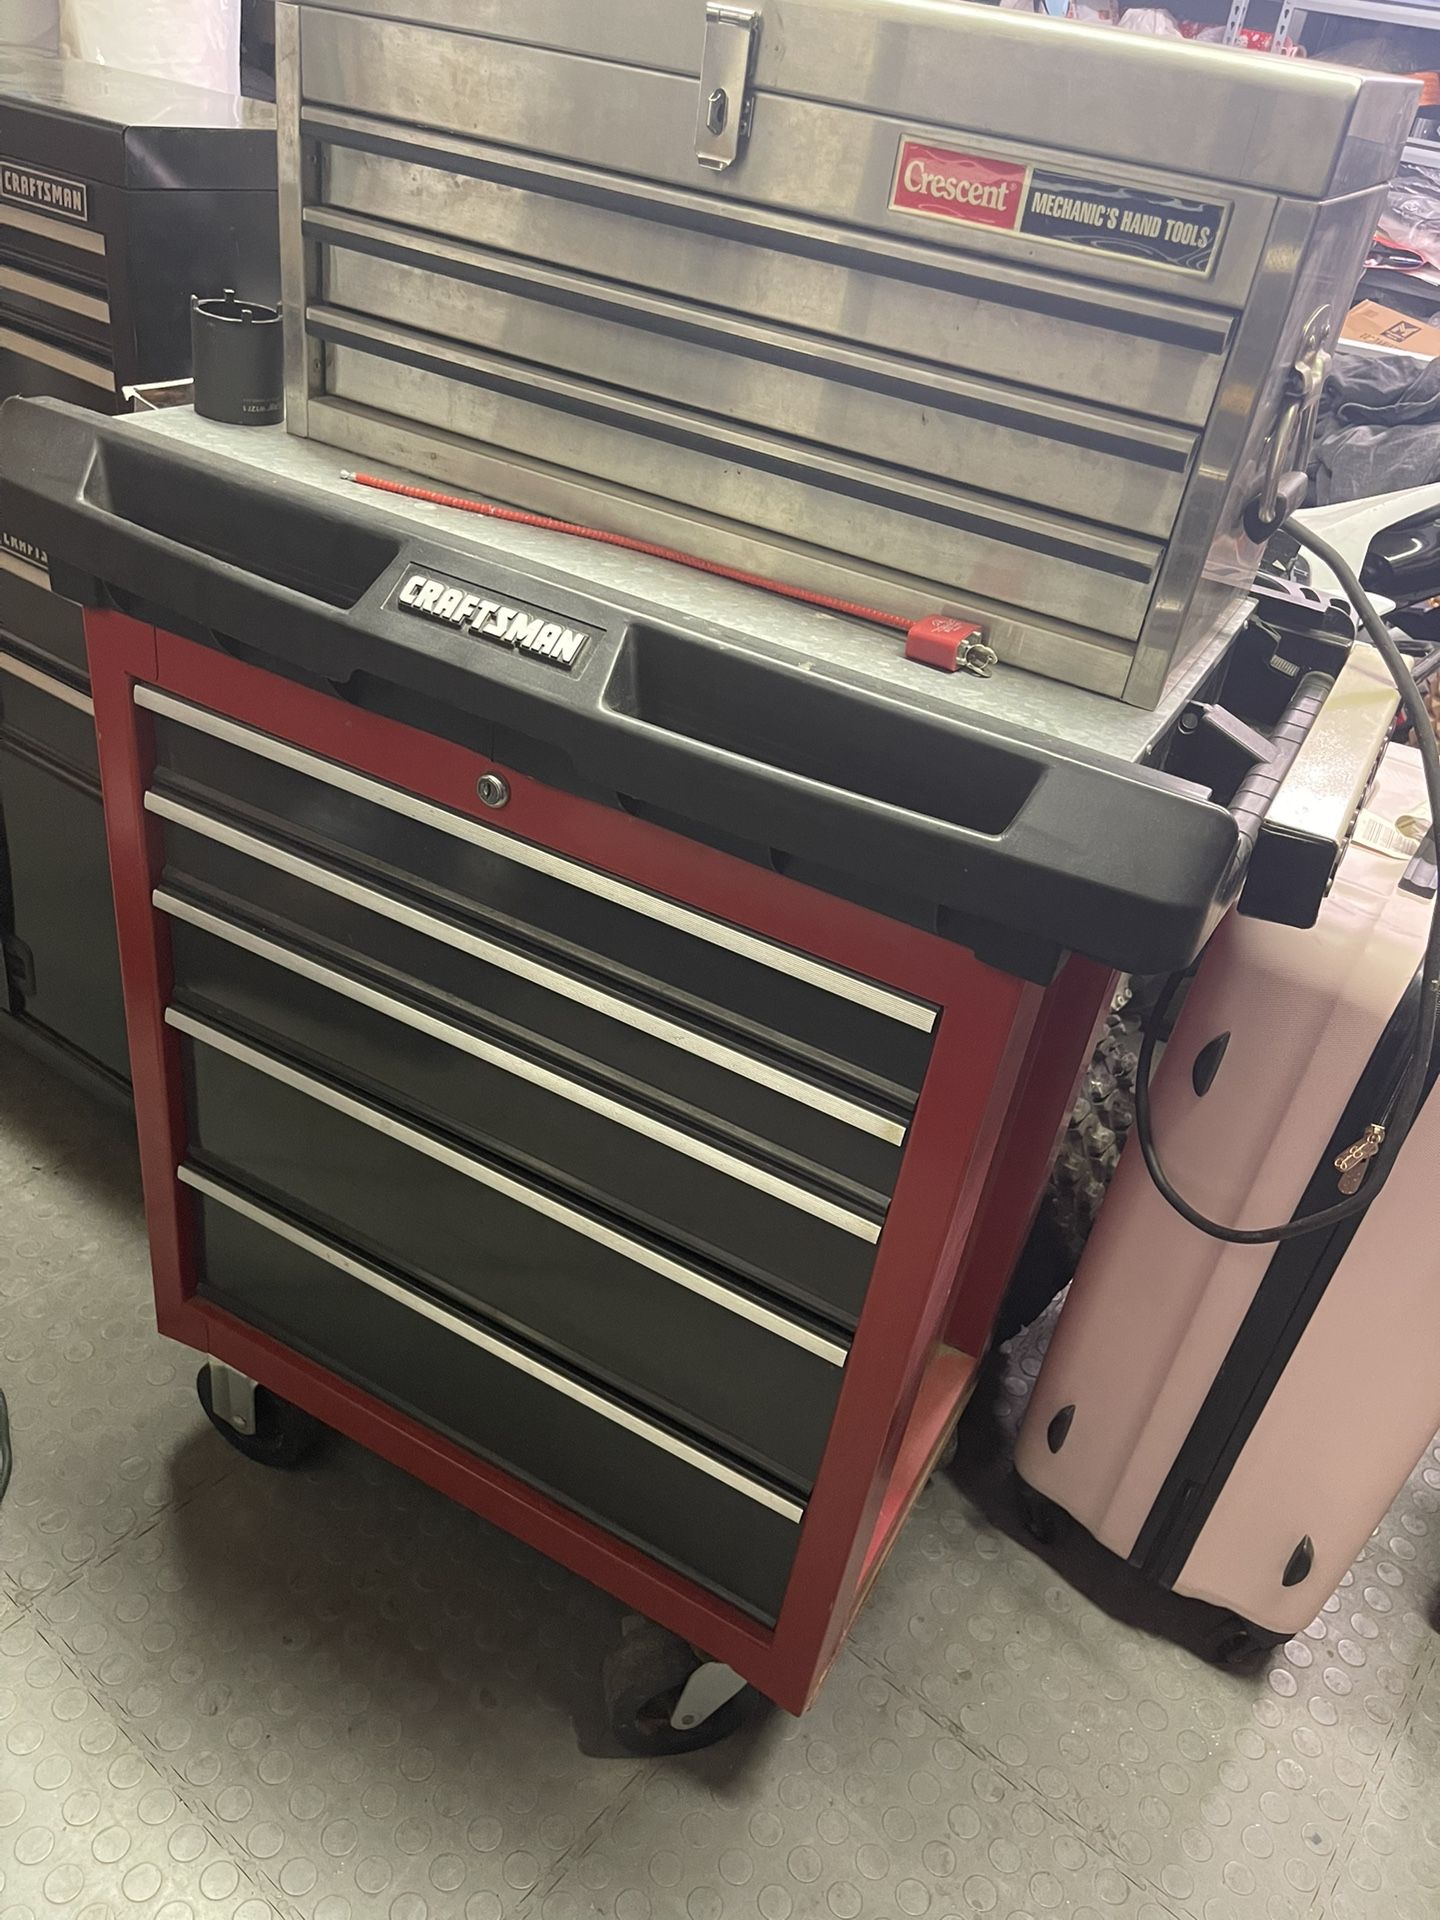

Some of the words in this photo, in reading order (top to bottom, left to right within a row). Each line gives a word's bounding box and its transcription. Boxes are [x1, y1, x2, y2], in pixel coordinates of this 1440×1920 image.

[4, 170, 82, 212] CRAFTSMAN
[904, 160, 1009, 211] Crescent
[1031, 191, 1119, 230] MECHANIC'S
[1120, 211, 1162, 238] HAND
[1164, 219, 1210, 249] TOOLS
[399, 575, 587, 664] CRAFTSMAN
